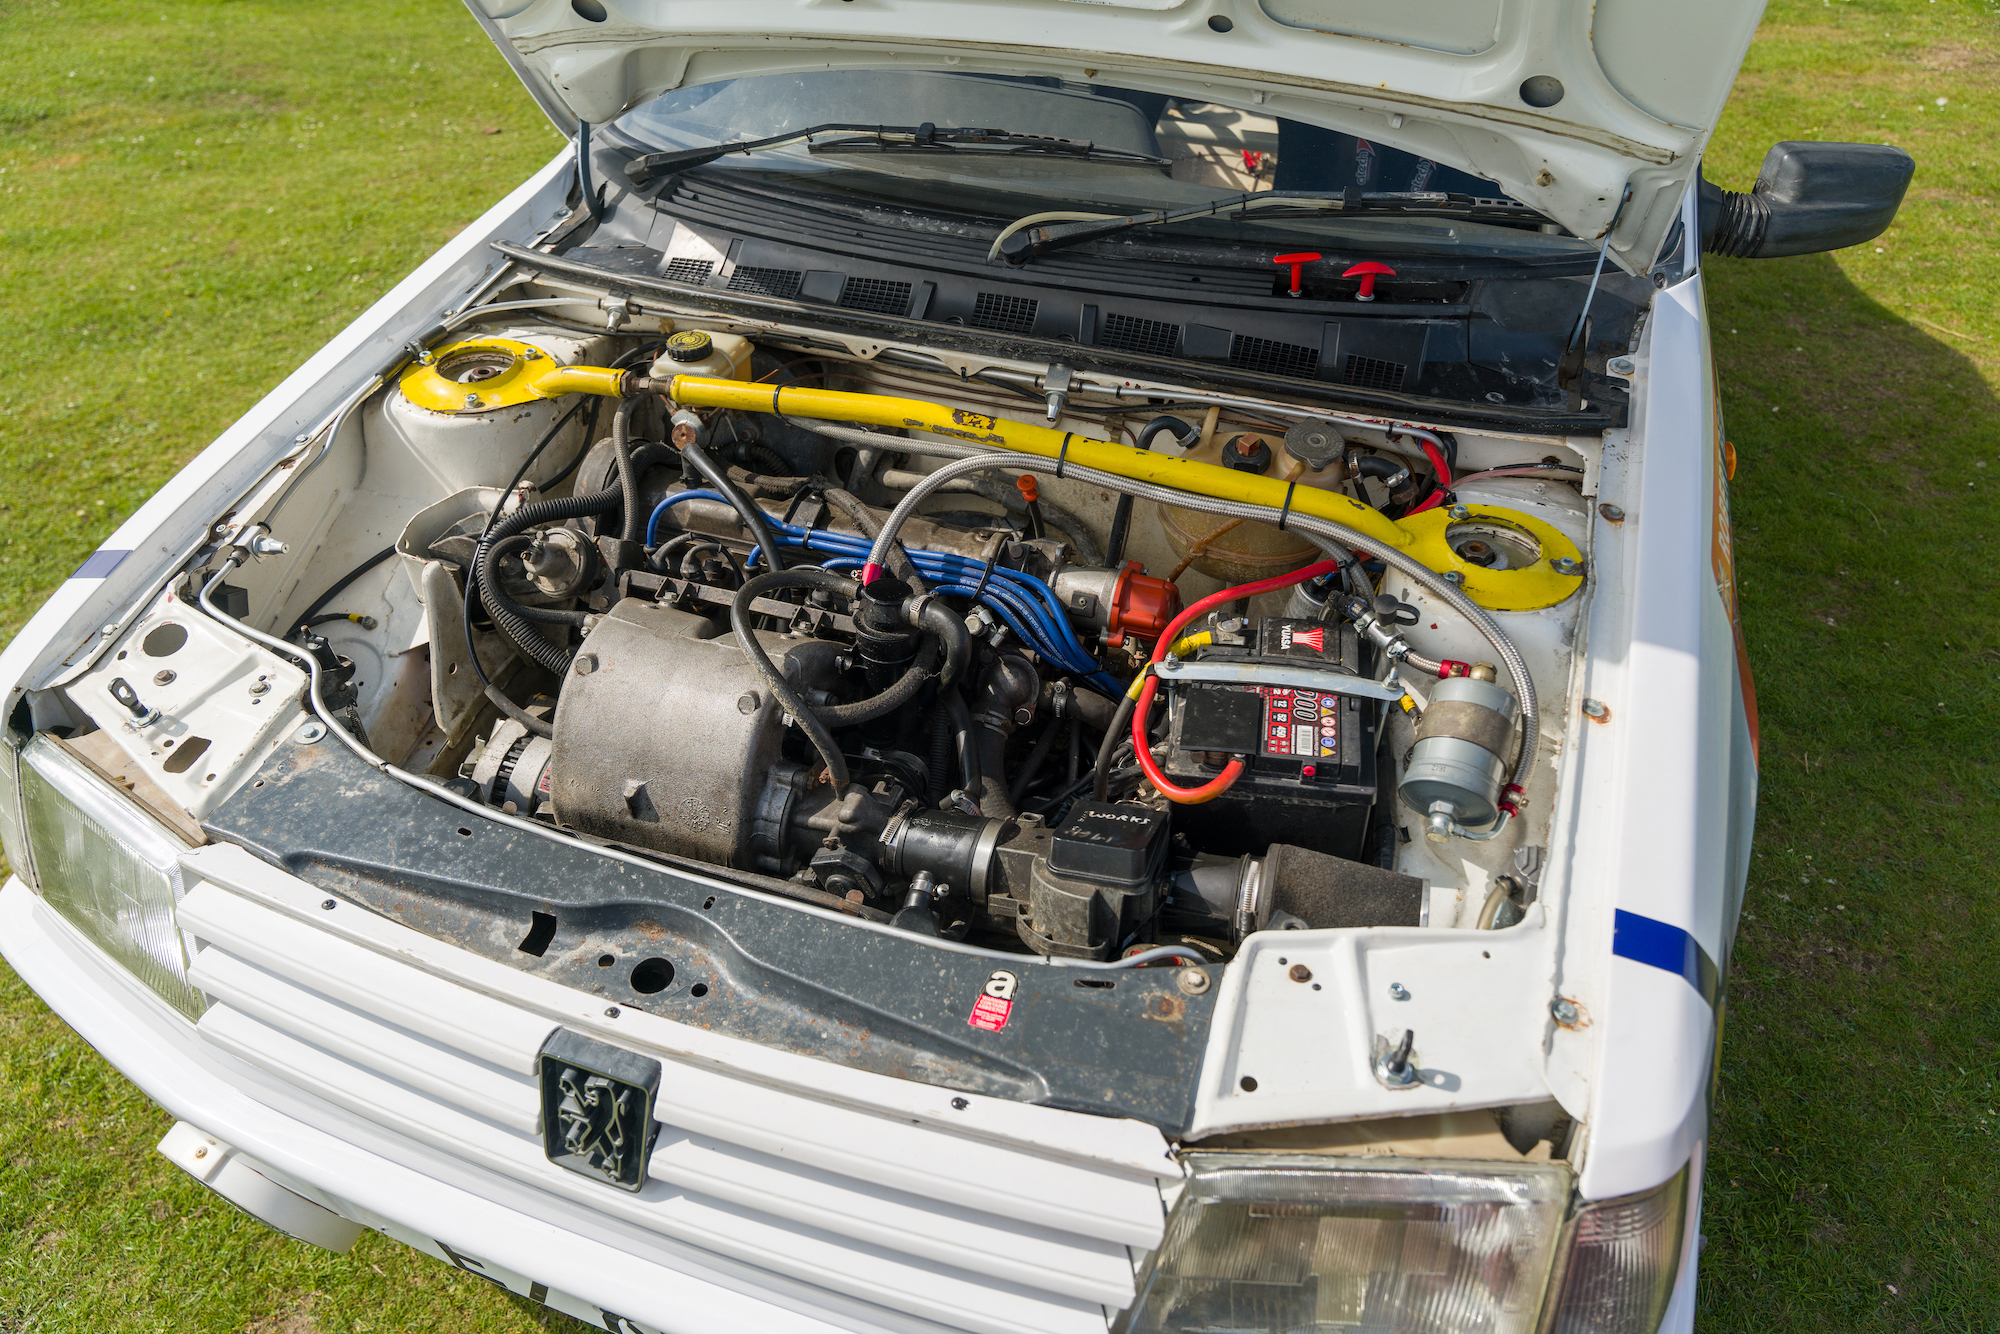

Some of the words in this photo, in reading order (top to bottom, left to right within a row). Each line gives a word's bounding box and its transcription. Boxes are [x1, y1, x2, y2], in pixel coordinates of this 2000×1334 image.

[1281, 624, 1292, 650] YUASA
[1277, 700, 1288, 708] 12
[1277, 713, 1288, 722] 52
[1276, 725, 1287, 738] 450
[1431, 764, 1447, 773] 1612
[985, 969, 1016, 1001] a
